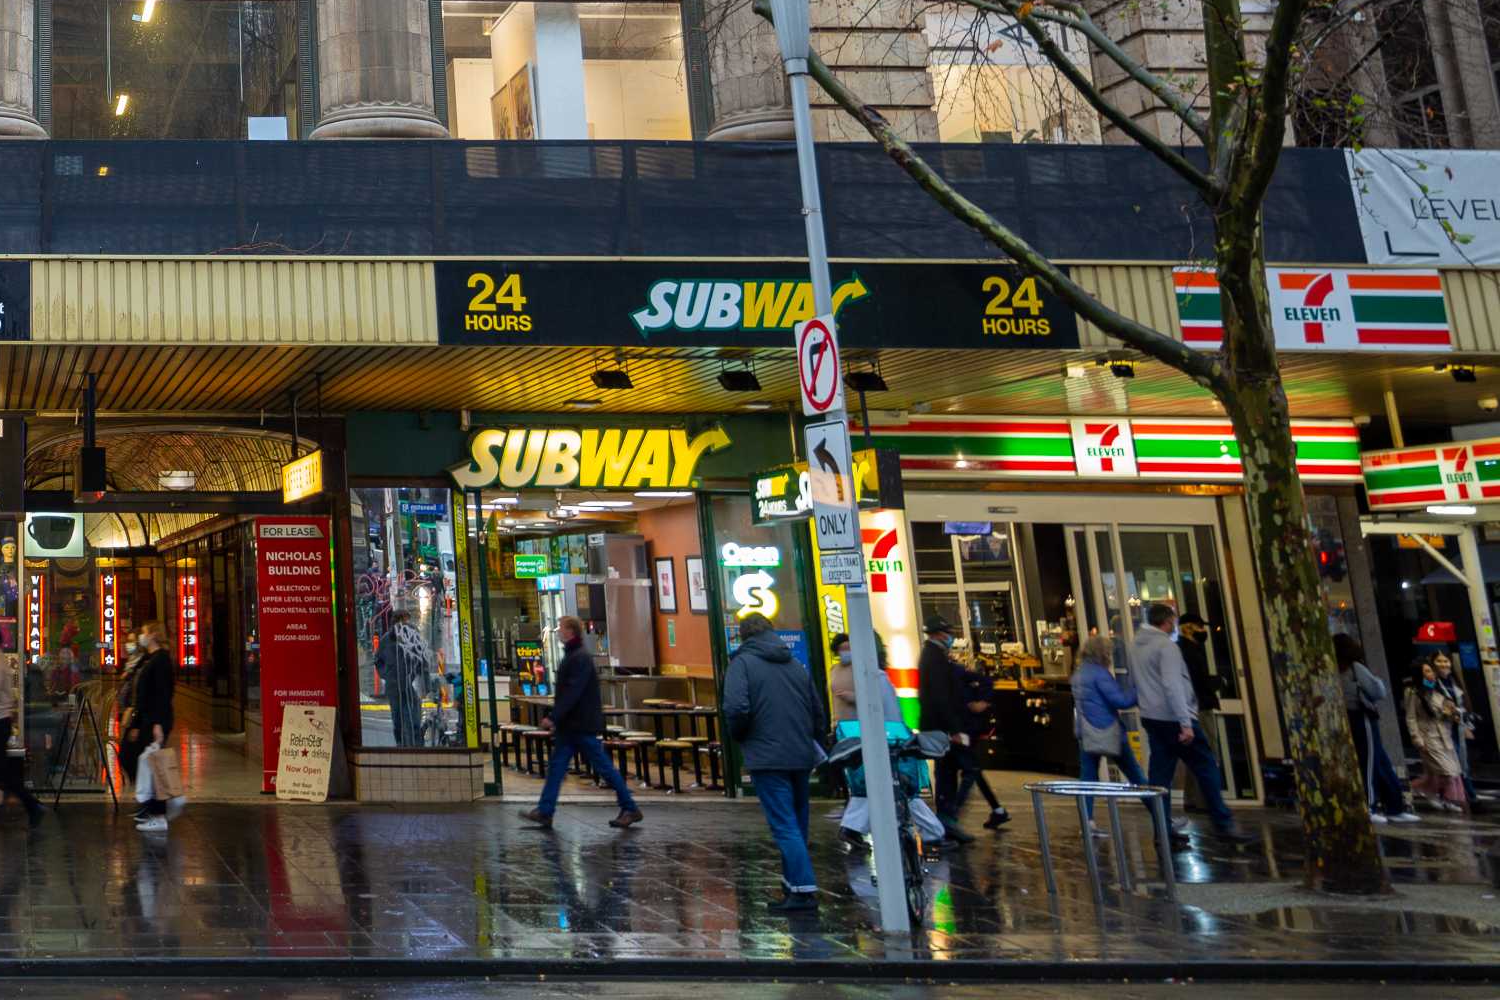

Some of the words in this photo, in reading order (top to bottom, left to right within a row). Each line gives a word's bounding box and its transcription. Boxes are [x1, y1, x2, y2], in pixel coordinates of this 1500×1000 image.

[467, 273, 527, 311] 24
[982, 276, 1044, 316] 24
[465, 314, 532, 332] HOURS
[982, 317, 1050, 336] HOURS
[447, 425, 733, 491] SUBWAY
[263, 527, 283, 536] FOR
[286, 527, 316, 536] LEASE
[819, 512, 848, 536] ONLY
[265, 551, 323, 561] NICHOLAS
[268, 566, 322, 576] BUILDING
[30, 575, 41, 664] VINTAGE
[285, 764, 301, 774] Now
[302, 765, 322, 777] Open
